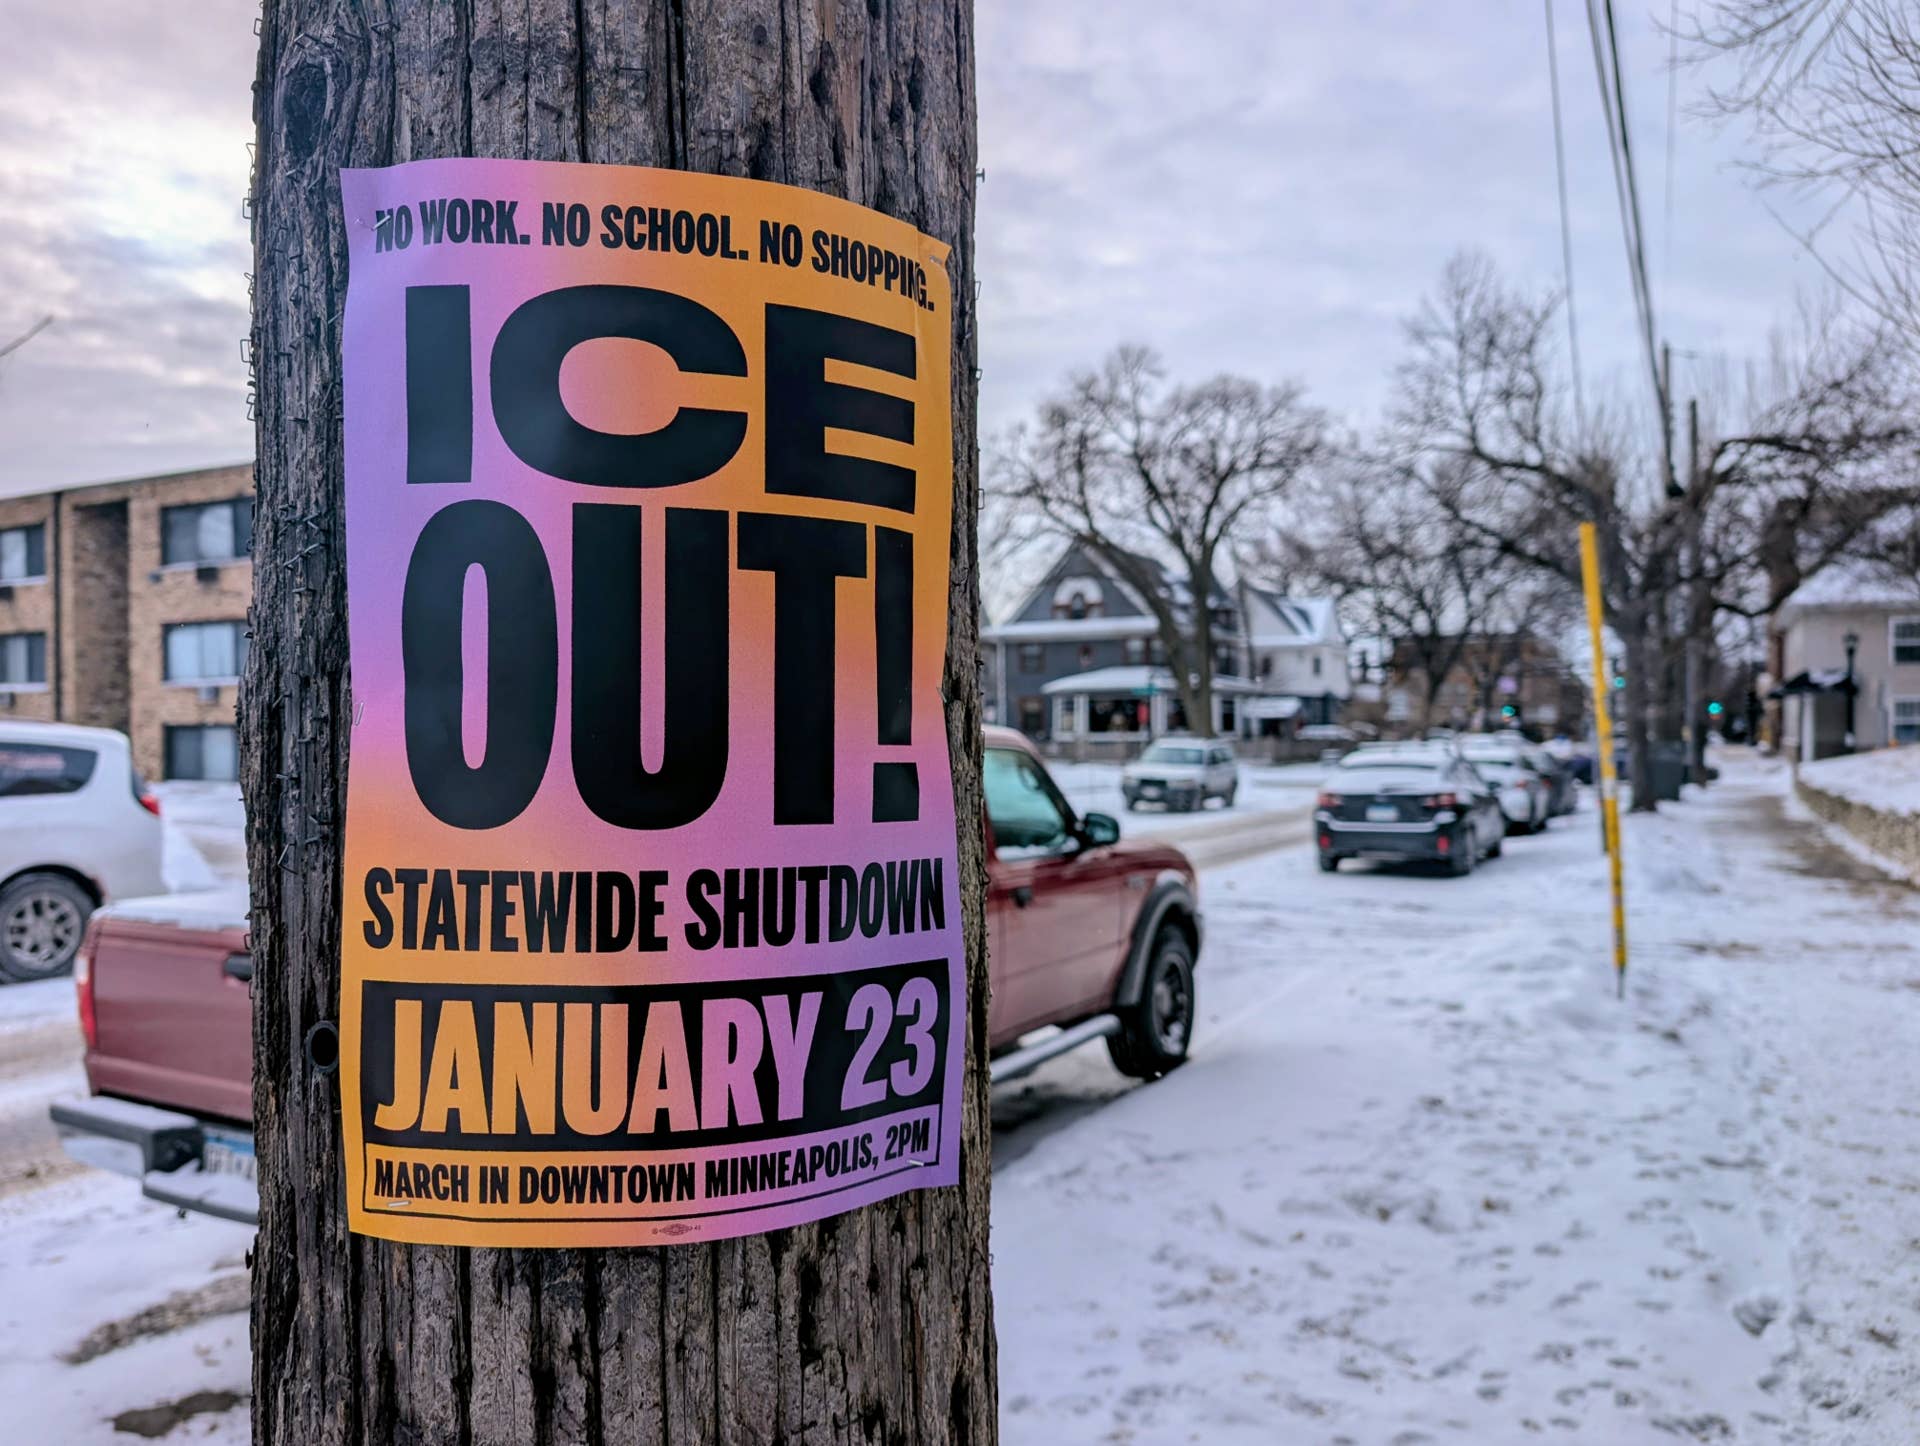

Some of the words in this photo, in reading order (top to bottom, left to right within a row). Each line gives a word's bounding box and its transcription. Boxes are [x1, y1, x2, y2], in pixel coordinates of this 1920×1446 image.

[375, 205, 413, 253] NO
[419, 198, 531, 245] WORK.
[542, 202, 590, 248] NO
[600, 205, 749, 261] SCHOOL.
[760, 220, 801, 267] NO
[811, 230, 935, 312] SHOPPING.
[405, 284, 917, 514] ICE
[402, 499, 920, 831] OUT!
[363, 867, 669, 953] STATEWIDE
[684, 858, 946, 951] SHUTDOWN
[374, 992, 823, 1136] JANUARY
[840, 976, 939, 1112] 23
[374, 1158, 469, 1203] MARCH
[479, 1165, 509, 1204] IN
[518, 1162, 695, 1205] DOWNTOWN
[705, 1138, 879, 1199] MINNEAPOLIS,
[885, 1119, 930, 1157] 2PM
